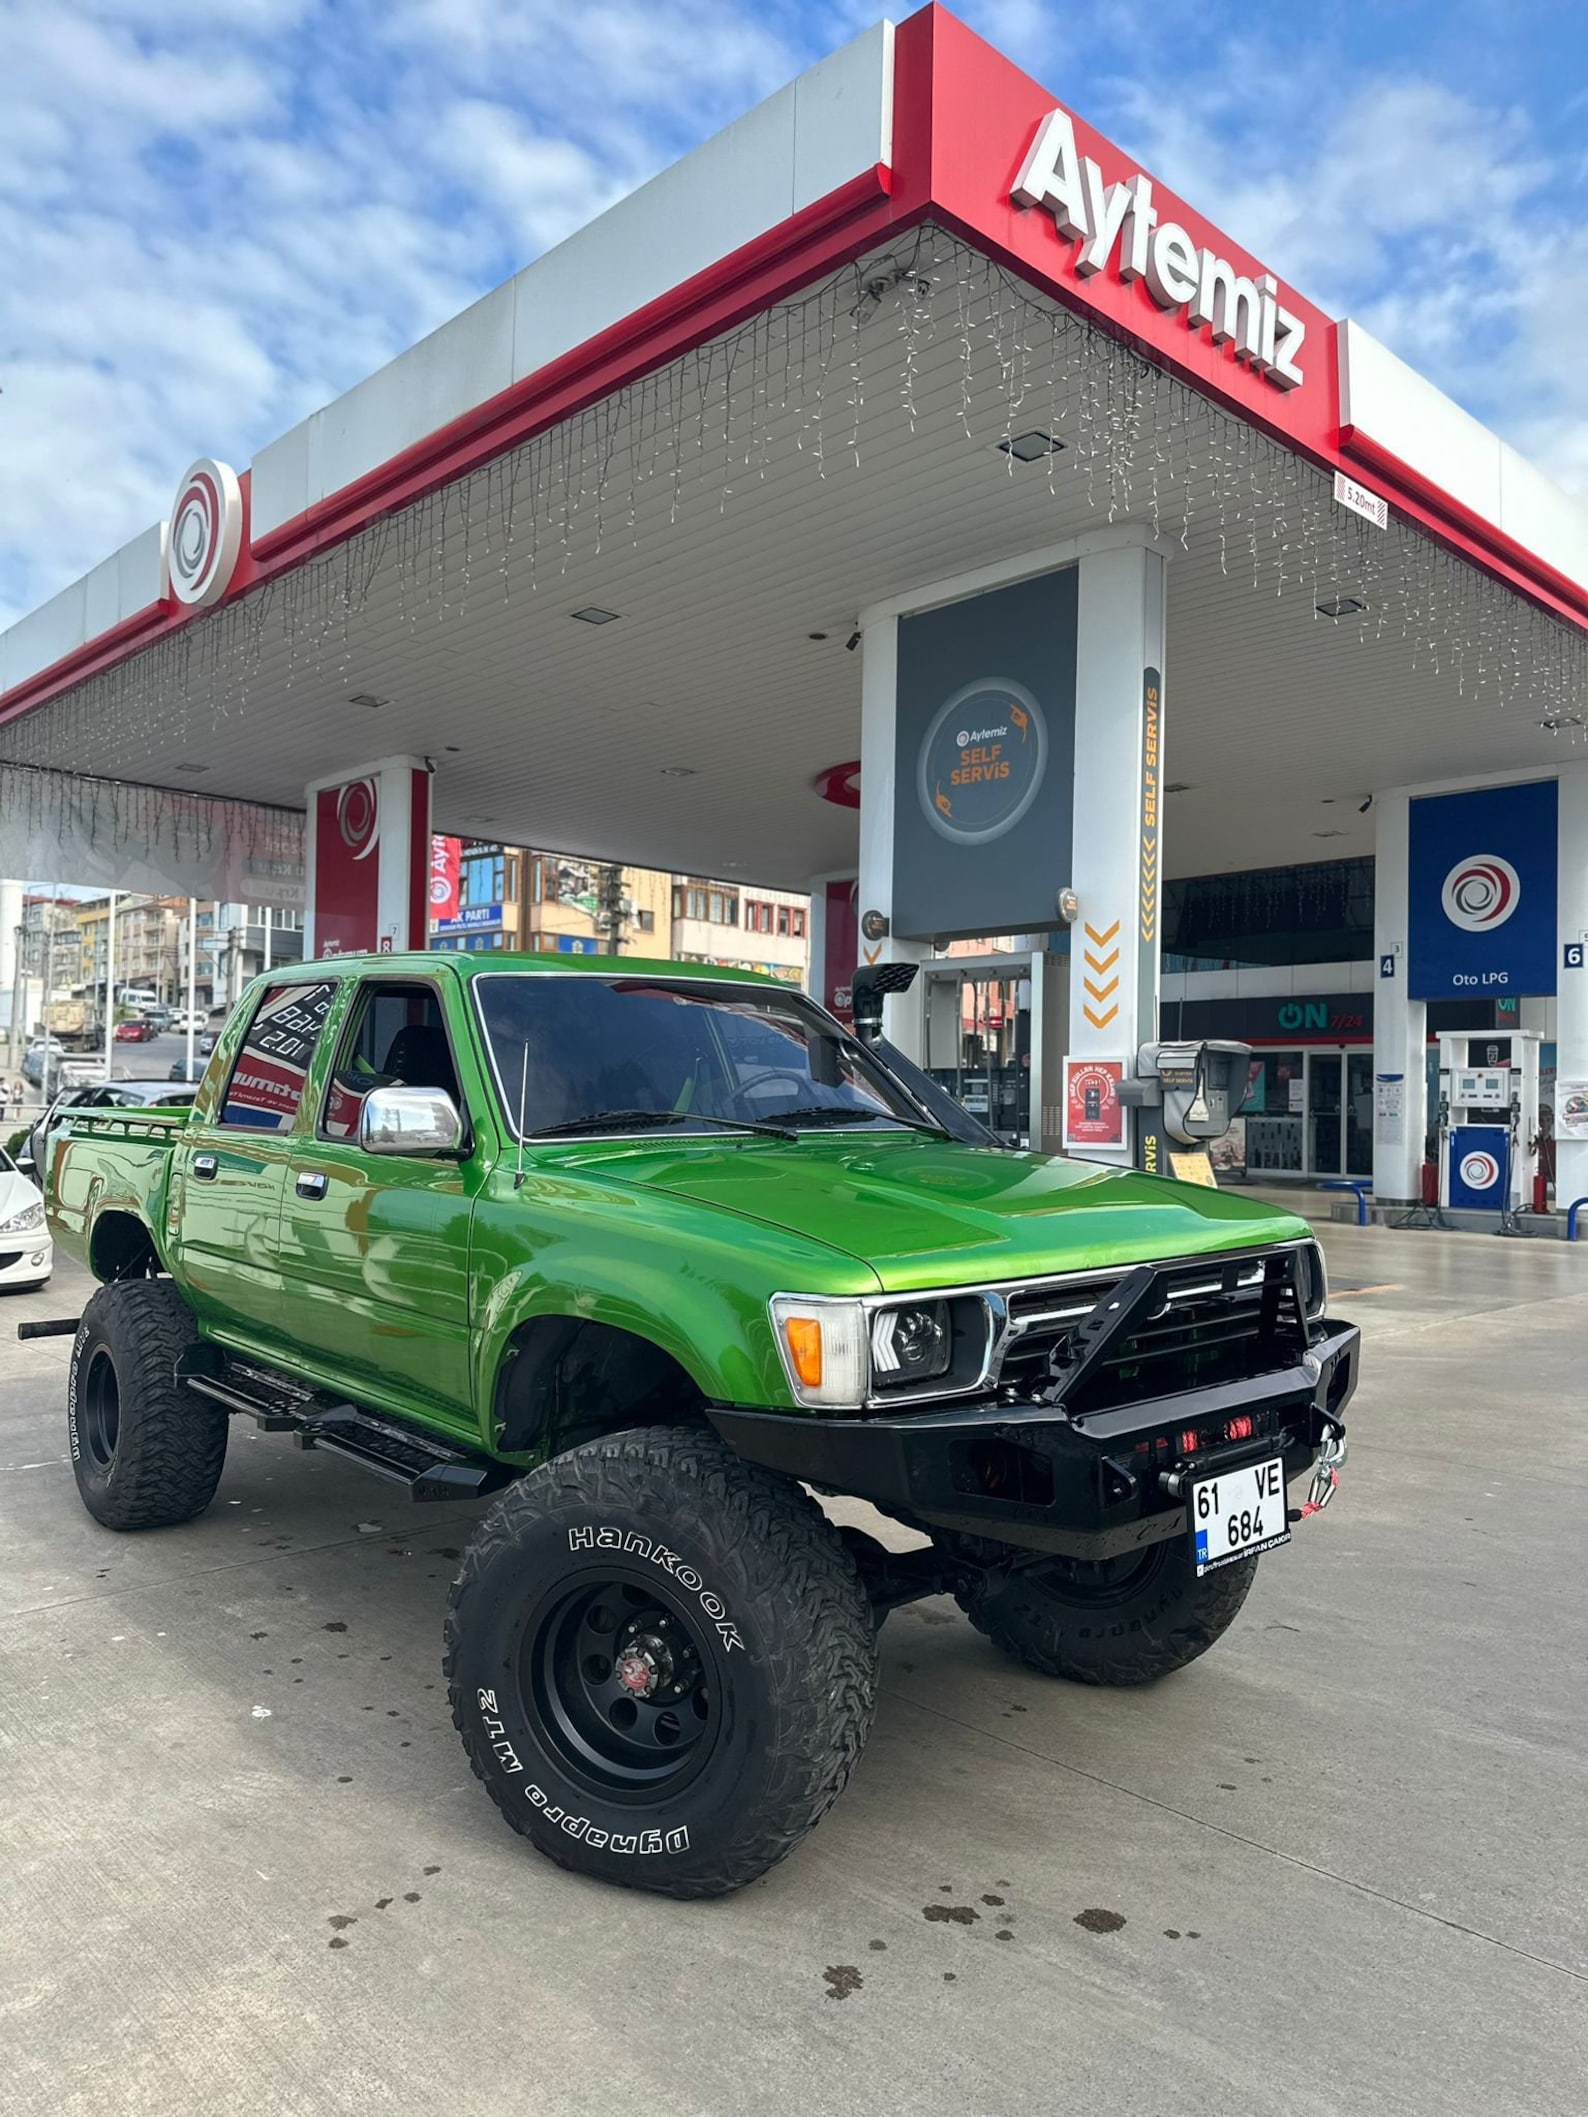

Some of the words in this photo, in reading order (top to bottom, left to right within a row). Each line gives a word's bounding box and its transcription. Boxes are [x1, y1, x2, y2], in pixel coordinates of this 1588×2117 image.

[1010, 107, 1304, 392] Aytemiz
[1348, 487, 1375, 515] 5.20mt
[970, 726, 1007, 742] Aytemiz
[961, 744, 1001, 766] SELF
[1145, 772, 1156, 826] SELF
[1394, 945, 1400, 953] 3
[1568, 948, 1581, 964] 6
[1383, 959, 1393, 974] 4
[1453, 974, 1478, 986] Oto
[1482, 971, 1509, 985] LPG
[1278, 1002, 1327, 1029] ON
[1198, 1482, 1219, 1519] 61
[1255, 1463, 1280, 1500] VE
[1228, 1505, 1264, 1547] 684
[1198, 1548, 1208, 1559] TR
[476, 1687, 523, 1775] MT2
[524, 1783, 691, 1855] Dynapro
